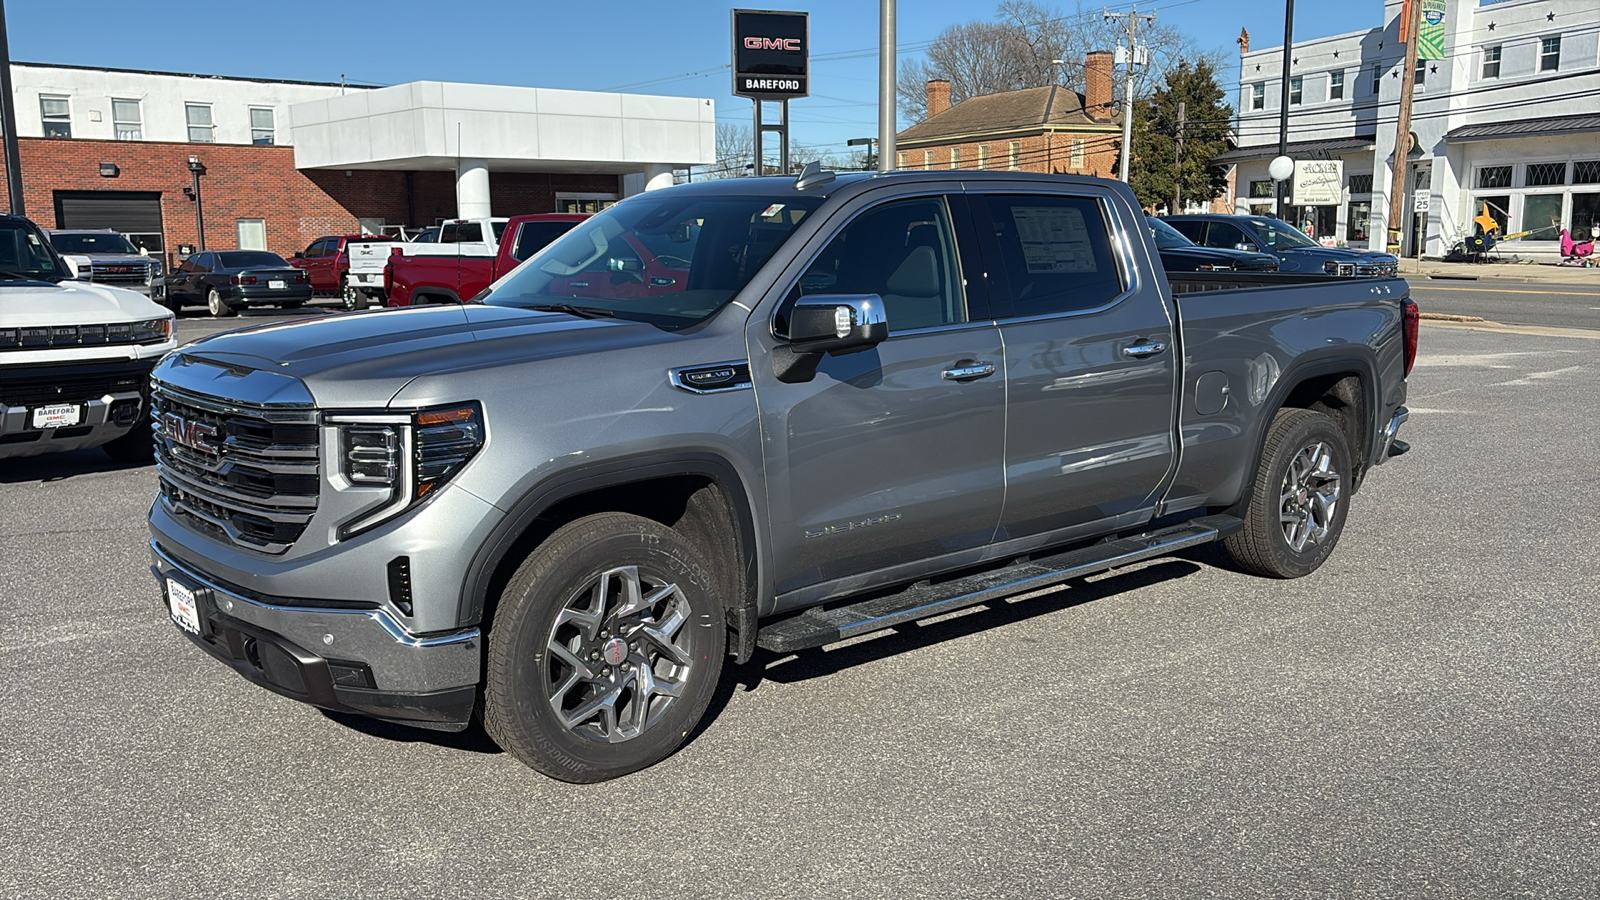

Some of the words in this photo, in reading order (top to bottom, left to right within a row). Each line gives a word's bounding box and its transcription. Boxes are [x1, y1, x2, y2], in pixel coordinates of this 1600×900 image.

[744, 37, 801, 51] GMC
[745, 79, 800, 90] BAREFORD
[1416, 200, 1429, 210] 25
[38, 407, 76, 417] BAREFORD
[163, 412, 218, 456] GMC
[170, 584, 195, 609] BAREFORD
